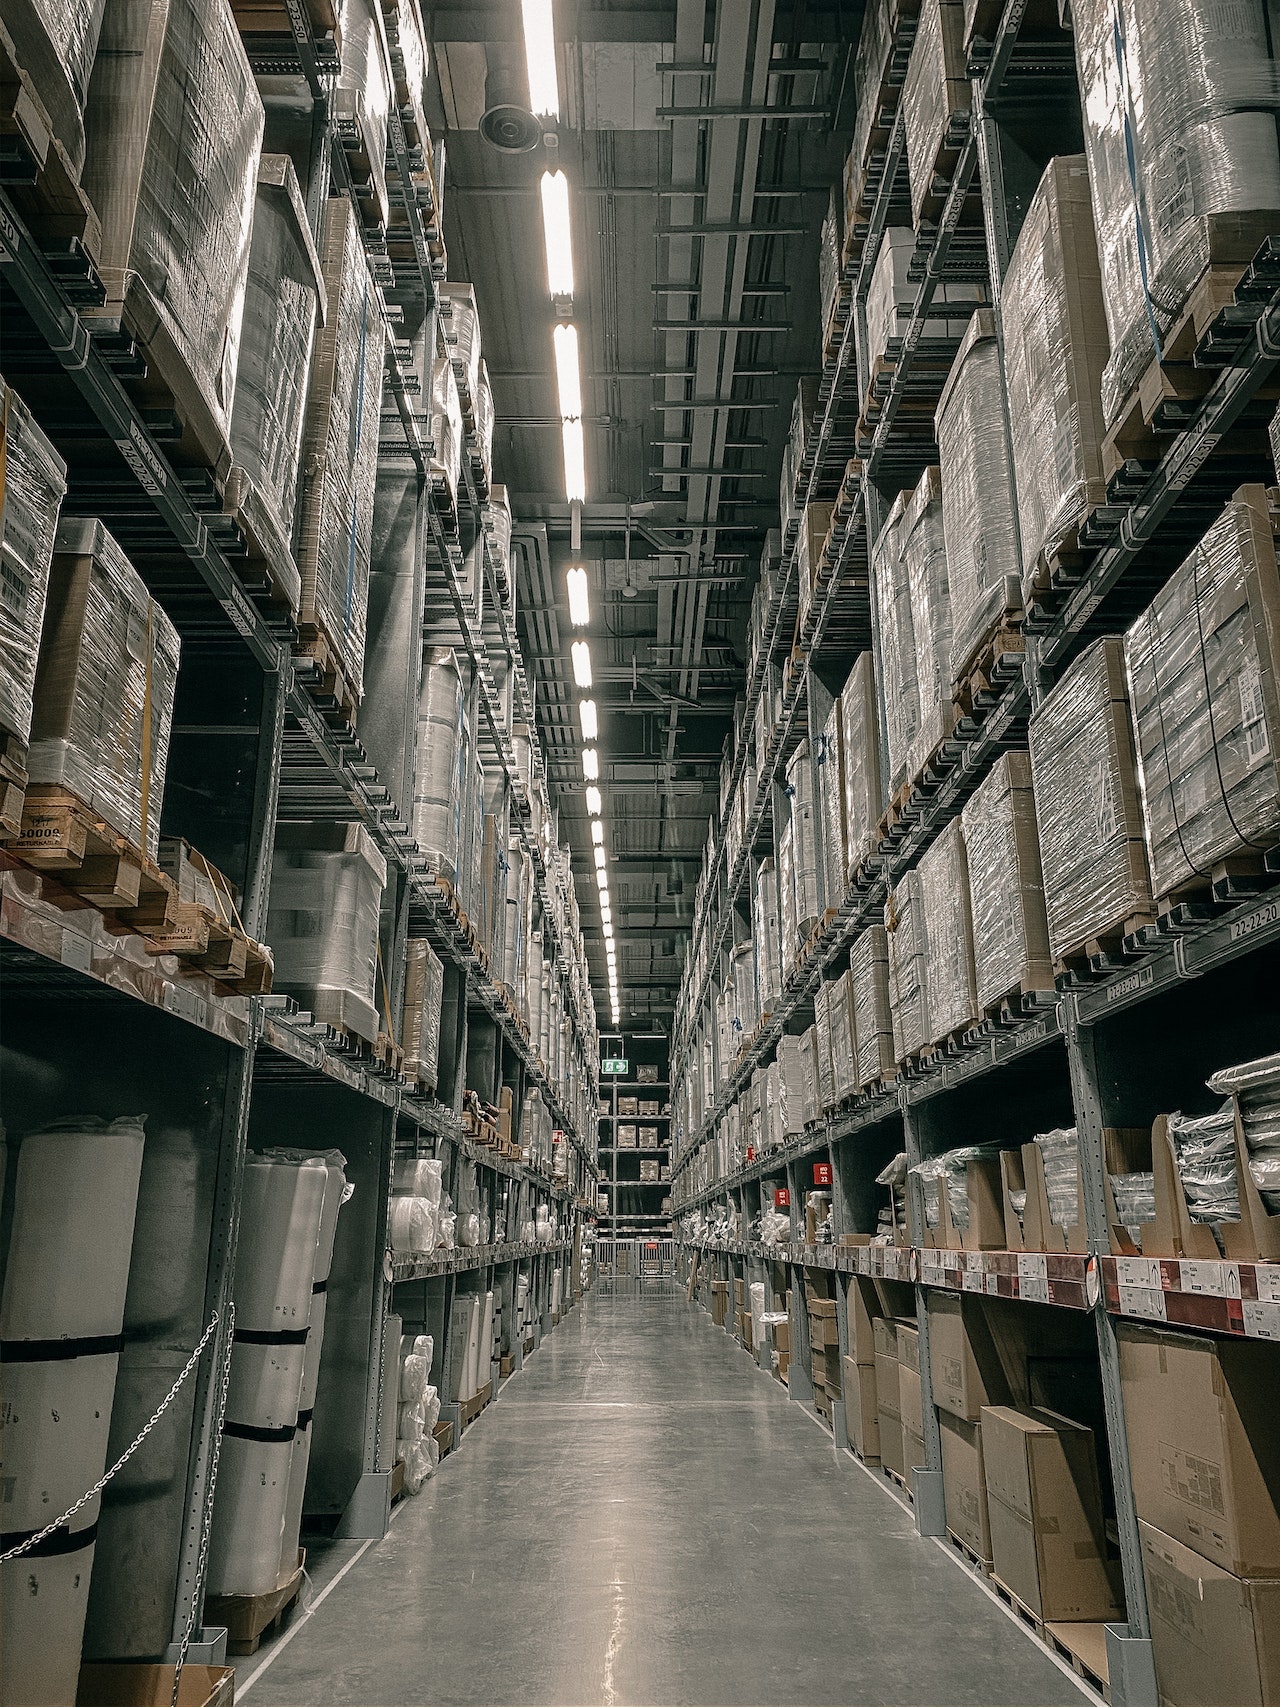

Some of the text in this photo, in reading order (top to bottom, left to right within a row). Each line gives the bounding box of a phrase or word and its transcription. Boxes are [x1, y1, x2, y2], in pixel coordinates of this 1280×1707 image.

[118, 445, 158, 491] 24-22-30
[1173, 438, 1217, 485] 22-22-30
[1235, 904, 1277, 937] 22-22-20
[1110, 976, 1137, 1000] 22-23-20
